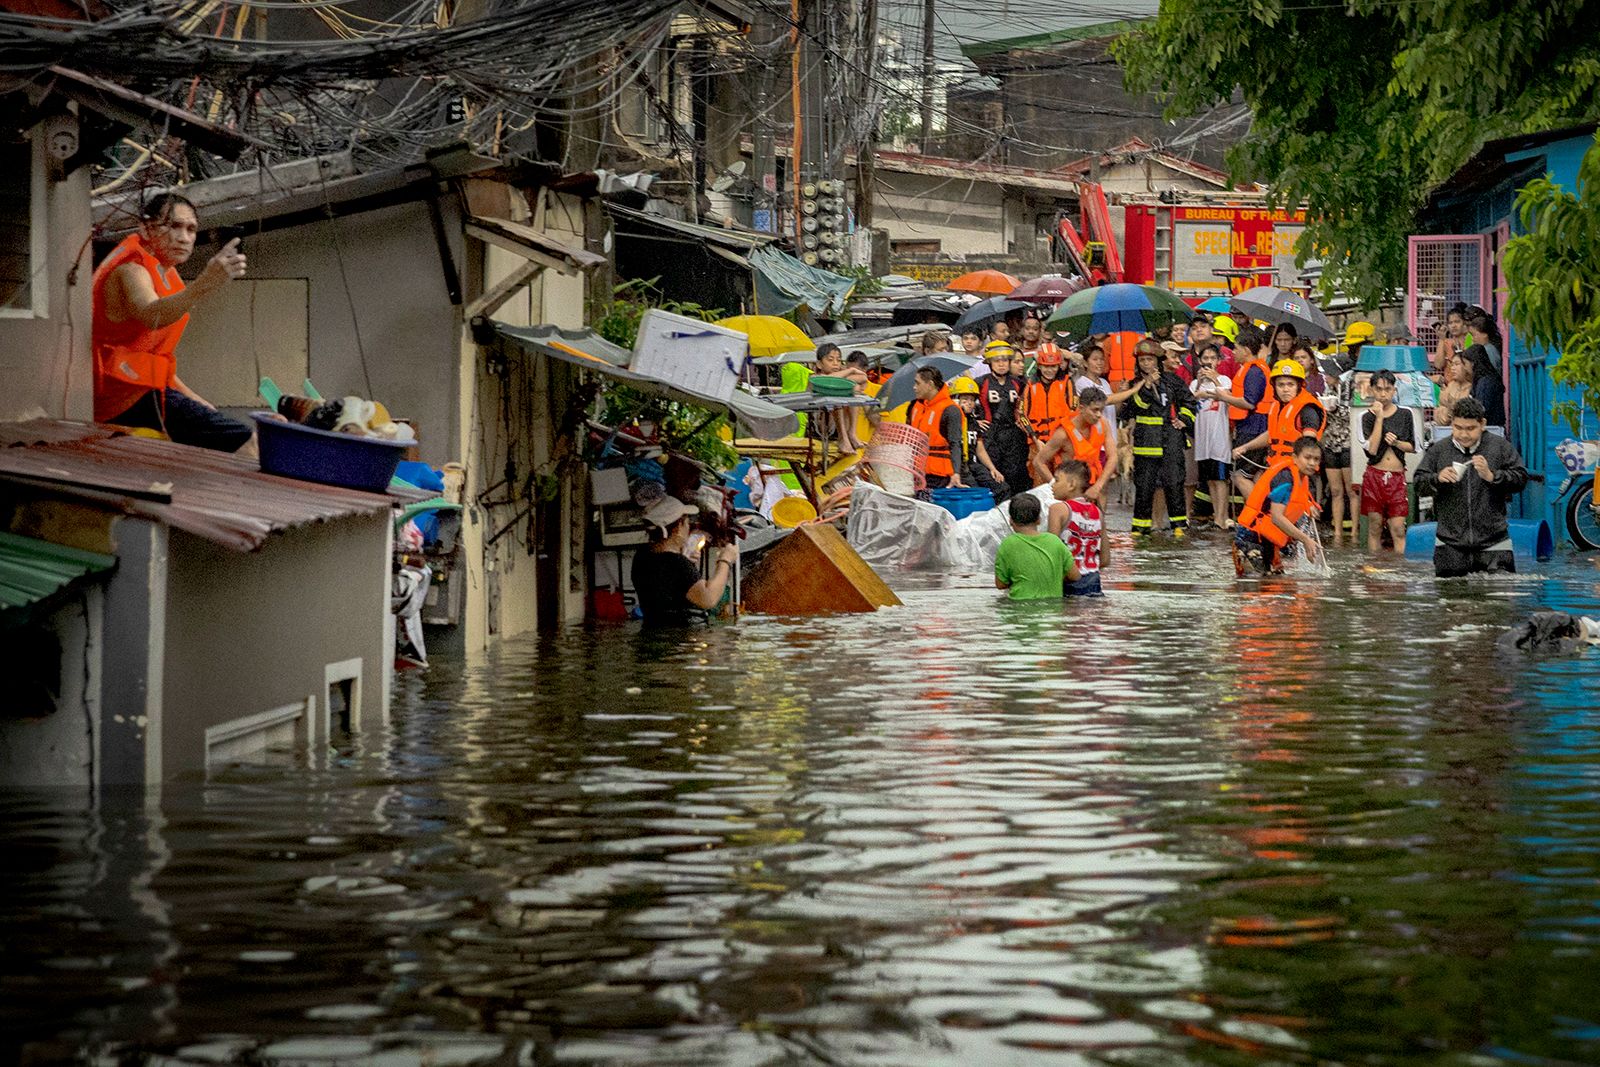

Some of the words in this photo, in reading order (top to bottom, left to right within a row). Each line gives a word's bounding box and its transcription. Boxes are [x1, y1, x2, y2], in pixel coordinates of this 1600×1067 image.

[1186, 209, 1234, 219] BUREAU
[1241, 211, 1258, 220] OF
[1260, 211, 1287, 221] FIRE
[1194, 231, 1248, 255] SPECIAL
[1256, 231, 1299, 256] RESCU
